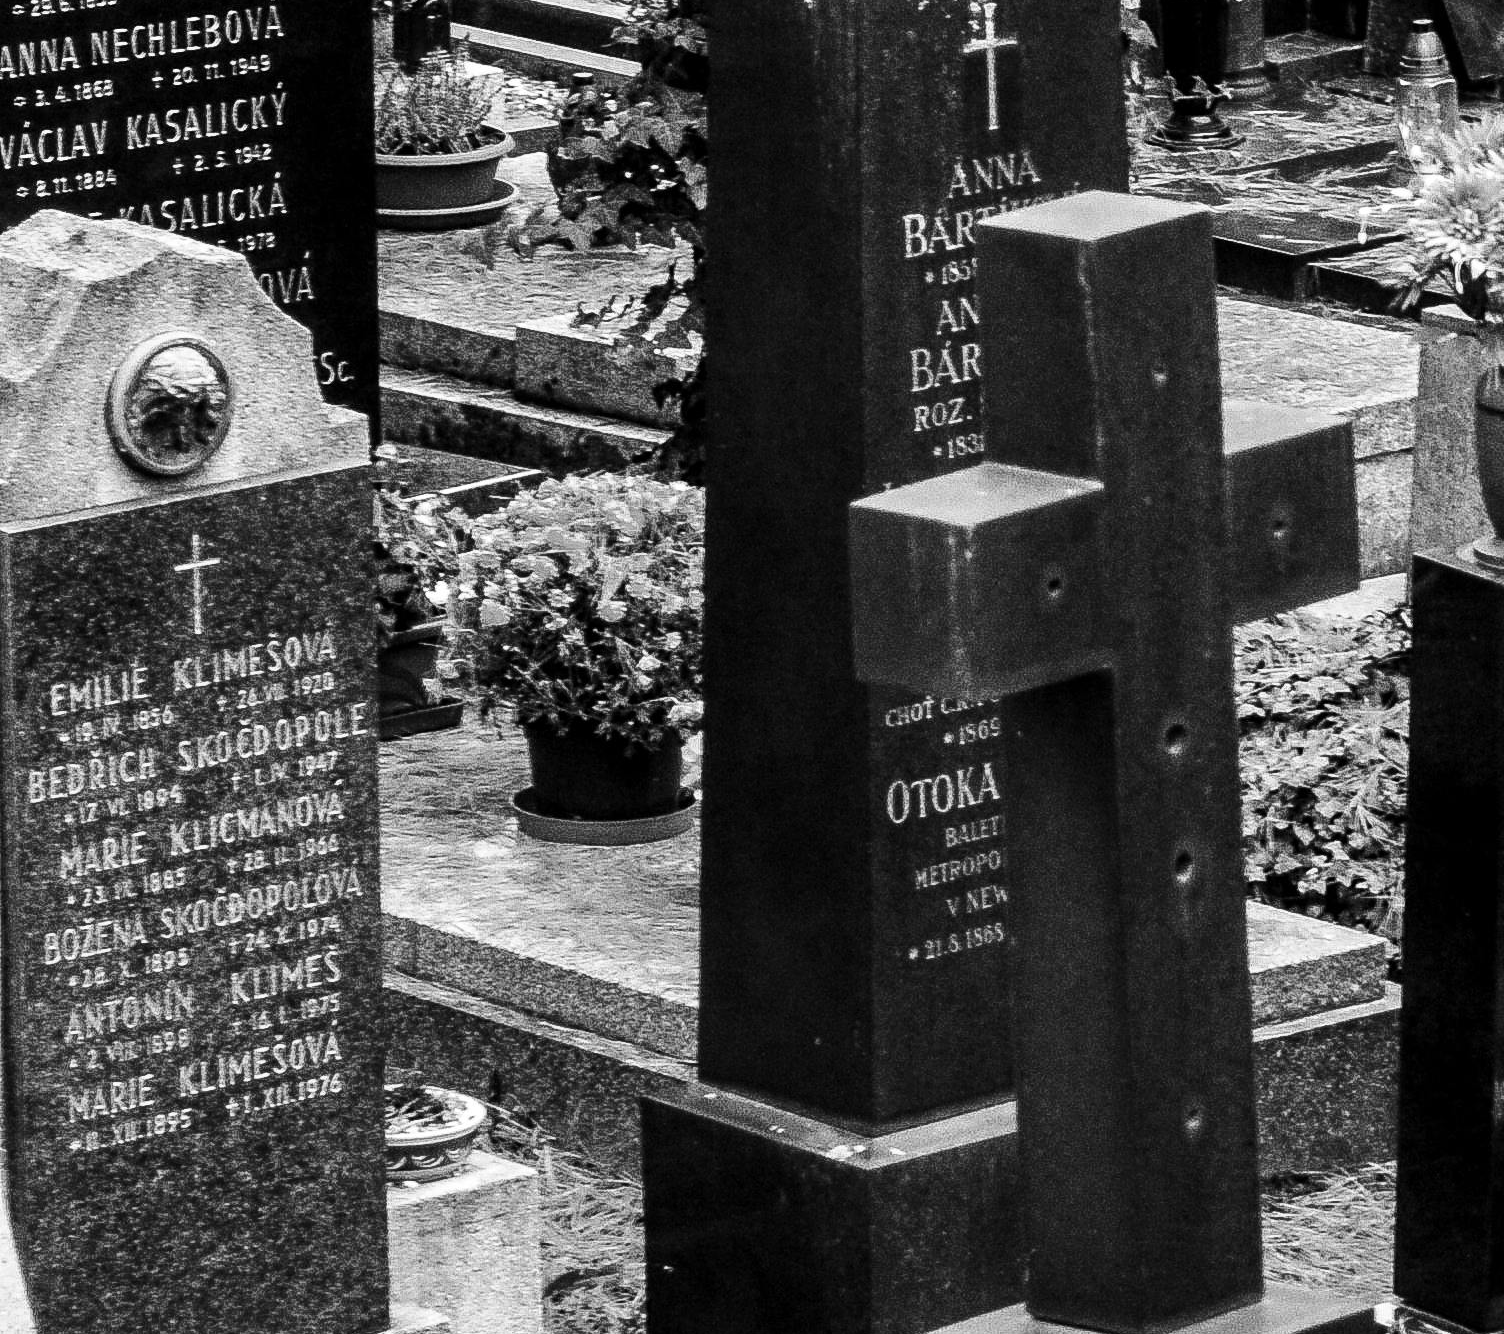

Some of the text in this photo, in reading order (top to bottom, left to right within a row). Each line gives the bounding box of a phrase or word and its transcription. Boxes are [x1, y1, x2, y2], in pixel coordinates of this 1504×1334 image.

[0, 36, 80, 80] ANNA
[0, 81, 287, 170] VÁCLAV KASALICKÝ
[914, 397, 973, 432] ROZ.
[50, 667, 152, 717] EMILIE
[28, 702, 369, 804] BEDŘICH SKOČDOPOLE
[60, 830, 148, 880] MARIE
[44, 914, 149, 966] BOŽENA
[64, 945, 342, 1044] ANTONÍN KLIMEŠ
[69, 1018, 343, 1124] MARIE KLIMEŠOVÁ
